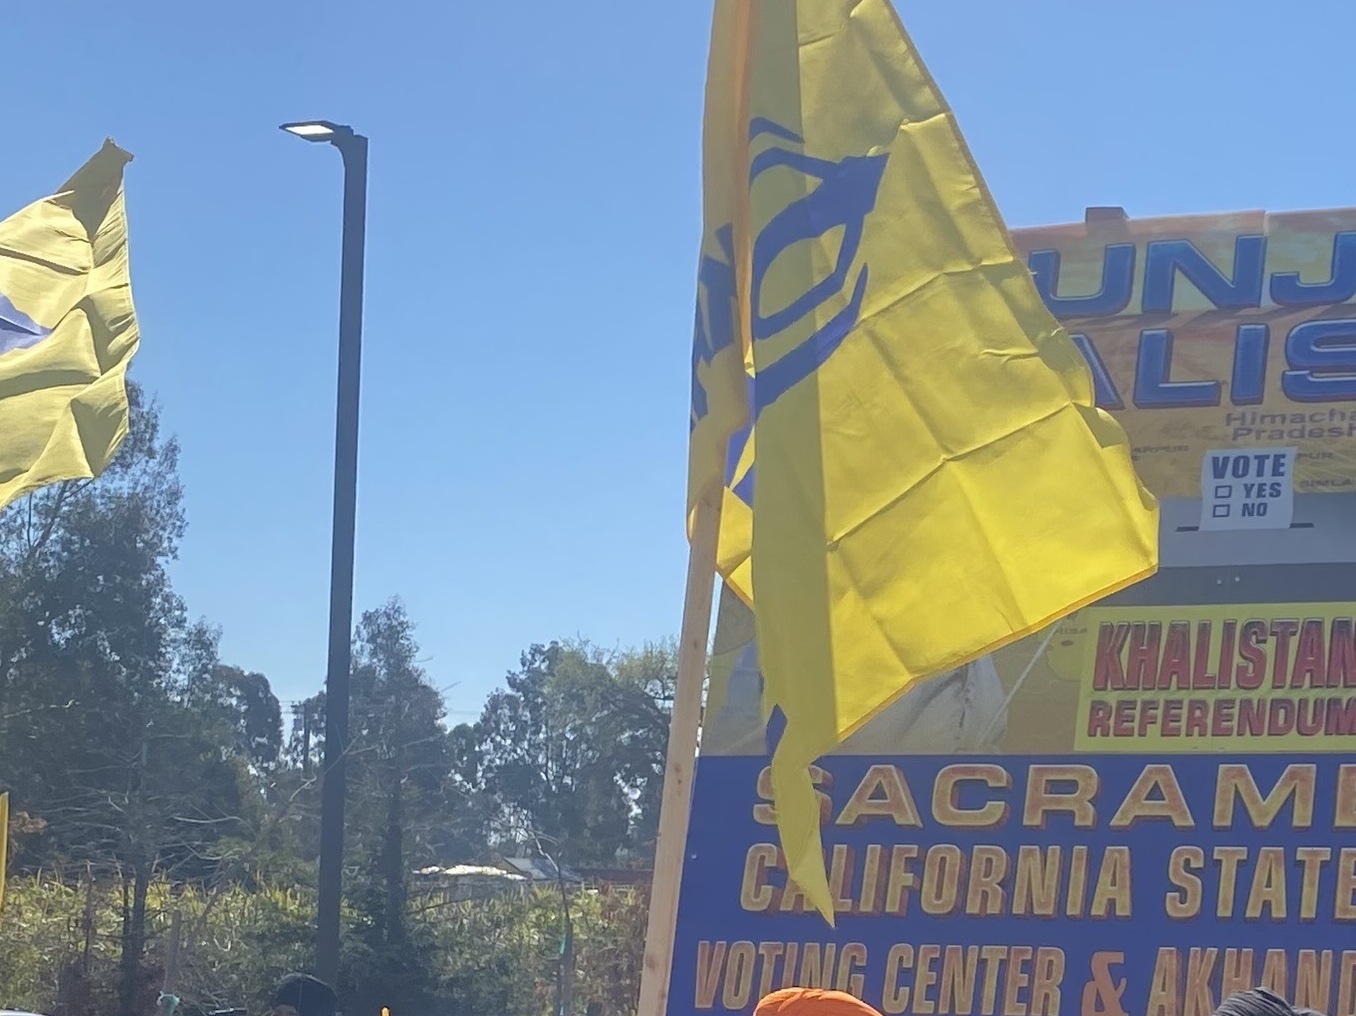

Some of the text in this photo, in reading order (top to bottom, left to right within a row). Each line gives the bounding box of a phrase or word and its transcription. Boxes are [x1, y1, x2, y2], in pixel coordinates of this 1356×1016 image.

[1212, 454, 1286, 479] VOTE
[1243, 482, 1282, 498] YES
[1241, 503, 1268, 517] NO
[694, 940, 867, 1010] VOTING
[881, 942, 1065, 1016] CENTER
